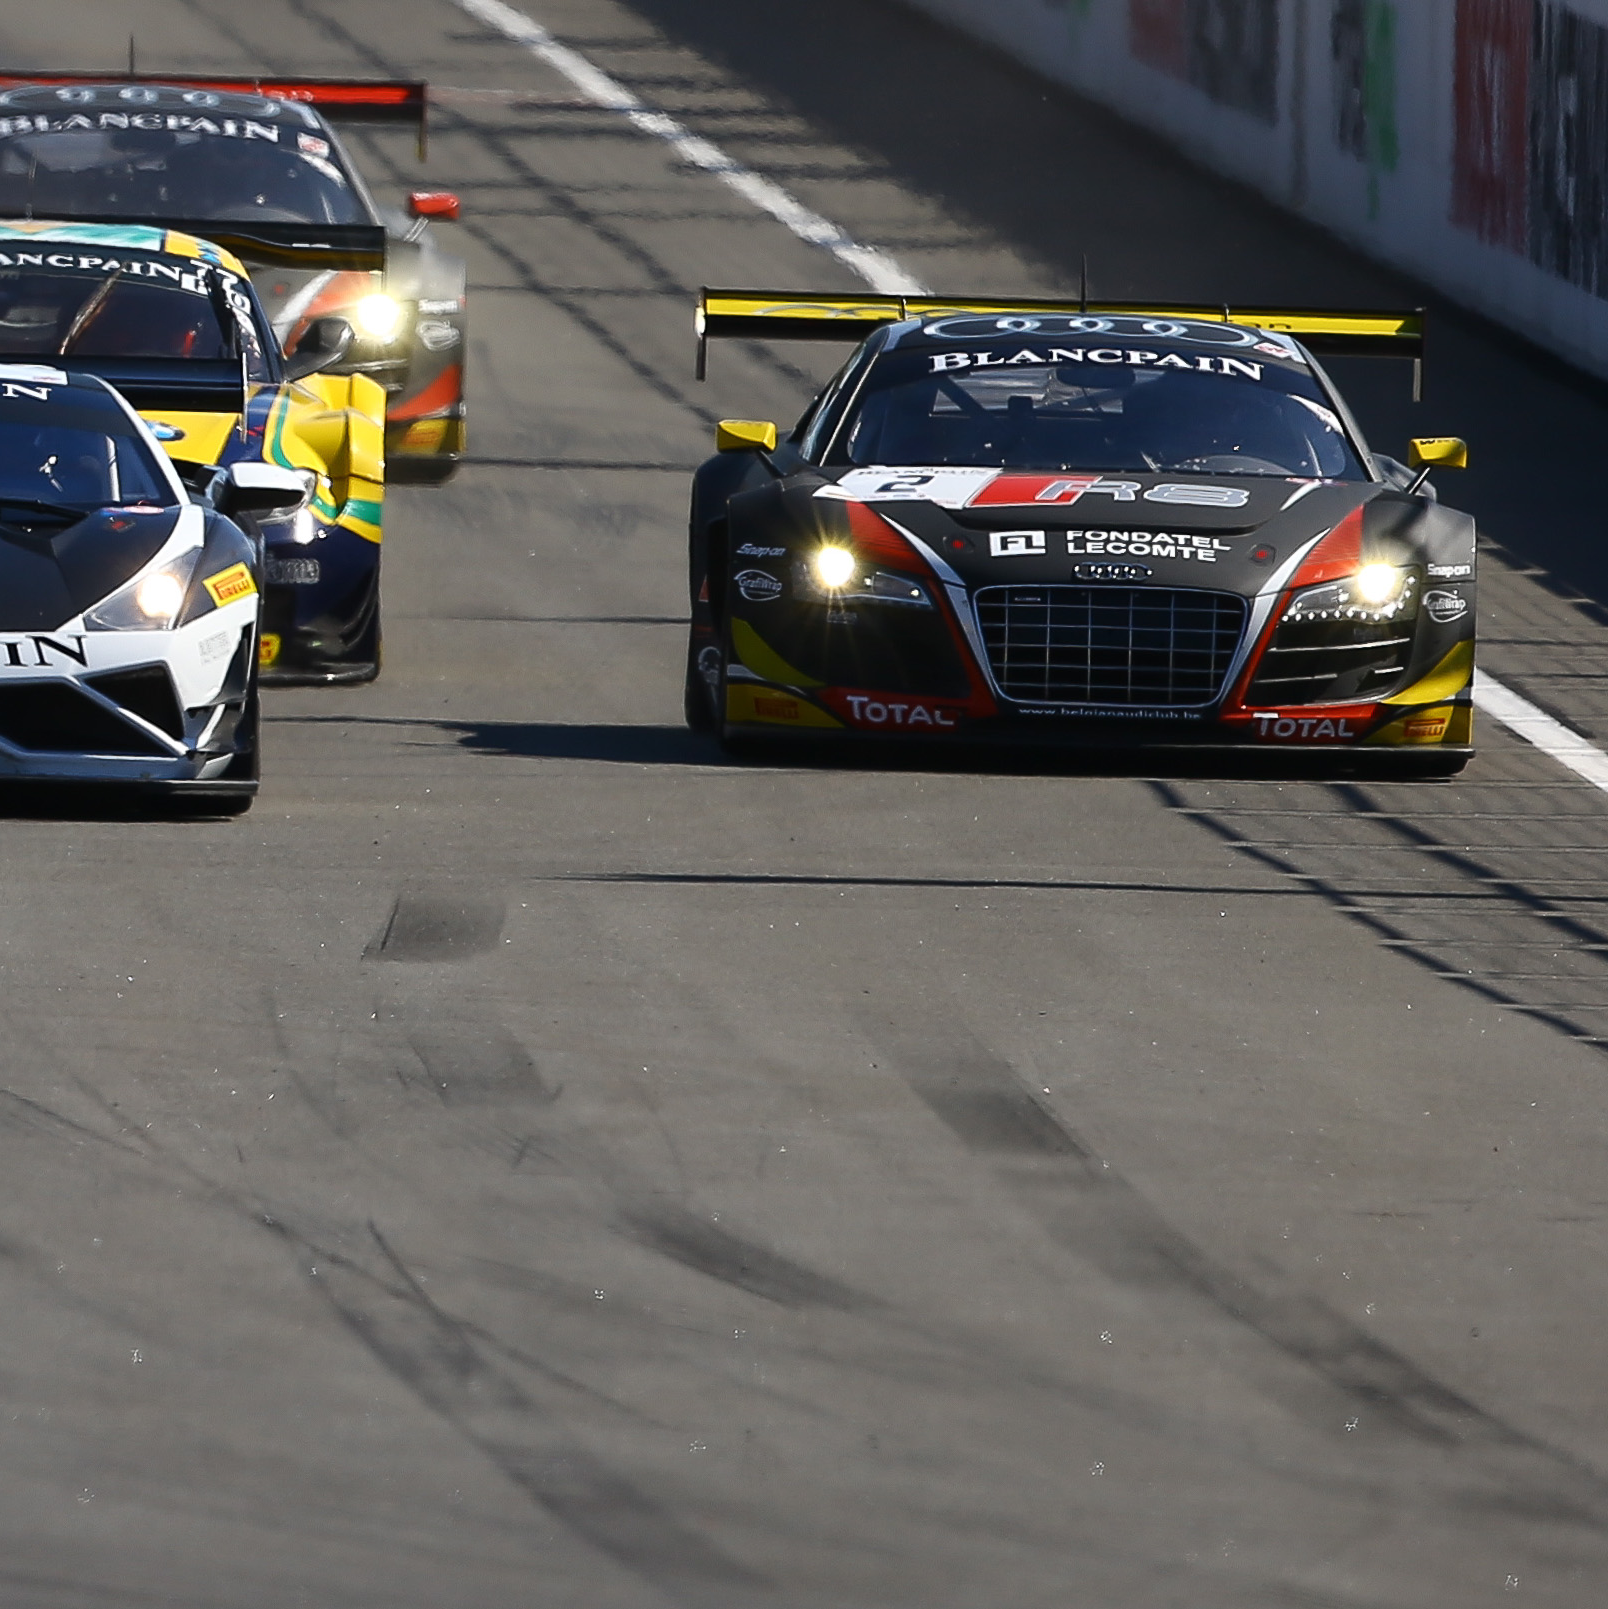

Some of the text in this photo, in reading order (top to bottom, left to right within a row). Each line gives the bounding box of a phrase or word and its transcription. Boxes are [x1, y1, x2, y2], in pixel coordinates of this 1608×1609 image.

[928, 347, 1265, 382] BLANCPAIN
[875, 475, 936, 494] 2
[1066, 529, 1232, 551] FONDATEL
[1067, 541, 1218, 563] LECOMTE
[845, 695, 955, 726] TOTAL
[1257, 717, 1356, 738] TOTAL
